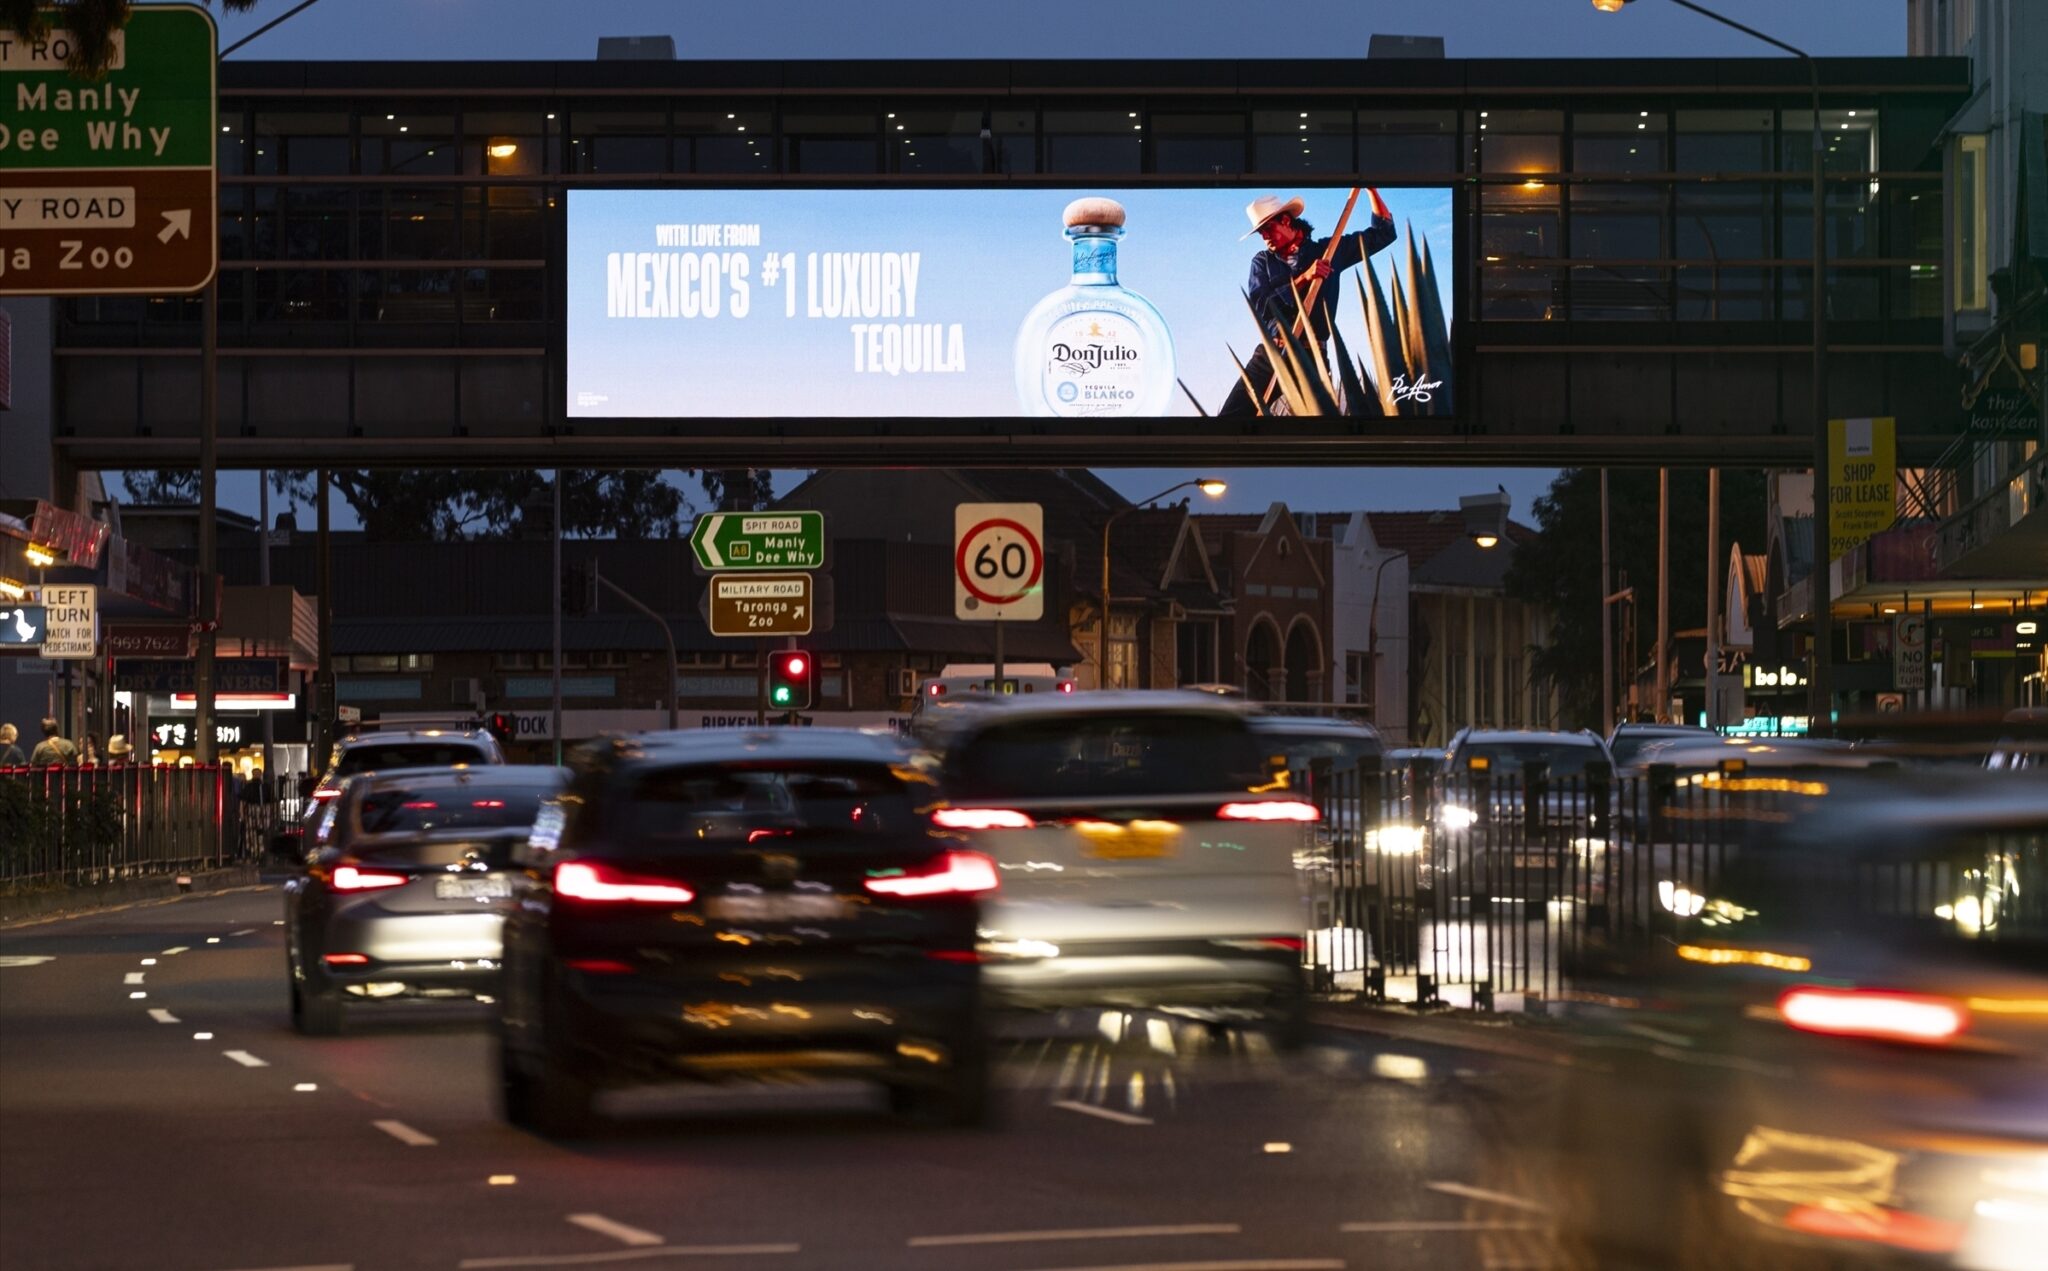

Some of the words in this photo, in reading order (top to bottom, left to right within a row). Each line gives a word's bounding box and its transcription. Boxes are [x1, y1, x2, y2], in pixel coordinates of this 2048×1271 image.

[17, 82, 140, 117] Manly
[87, 121, 171, 156] Why
[42, 197, 125, 218] ROAD
[656, 224, 688, 247] WITH
[691, 224, 721, 247] LOVE
[723, 224, 760, 247] FROM
[59, 240, 134, 270] Zoo
[607, 252, 750, 318] MEXICO'S
[761, 252, 796, 318] #1
[807, 252, 921, 318] LUXURY
[850, 324, 966, 376] TEQUILA
[1085, 391, 1134, 400] BLANCO
[1843, 463, 1876, 482] SHOP
[1830, 485, 1852, 504] FOR
[1856, 483, 1890, 503] LEASE
[745, 521, 768, 531] SPIT
[772, 520, 799, 530] ROAD
[765, 536, 806, 550] Manly
[756, 551, 780, 564] Dee
[787, 550, 814, 565] Why
[974, 542, 1026, 580] 60
[721, 585, 770, 594] MILITARY
[773, 584, 801, 594] ROAD
[48, 590, 88, 604] LEFT
[47, 608, 90, 622] TURN
[735, 600, 788, 615] Taronga
[748, 615, 773, 627] Zoo
[77, 627, 92, 639] FOR
[44, 641, 92, 653] PEDESTRIANS
[1903, 651, 1923, 663] NO
[168, 674, 274, 690] CLNERS
